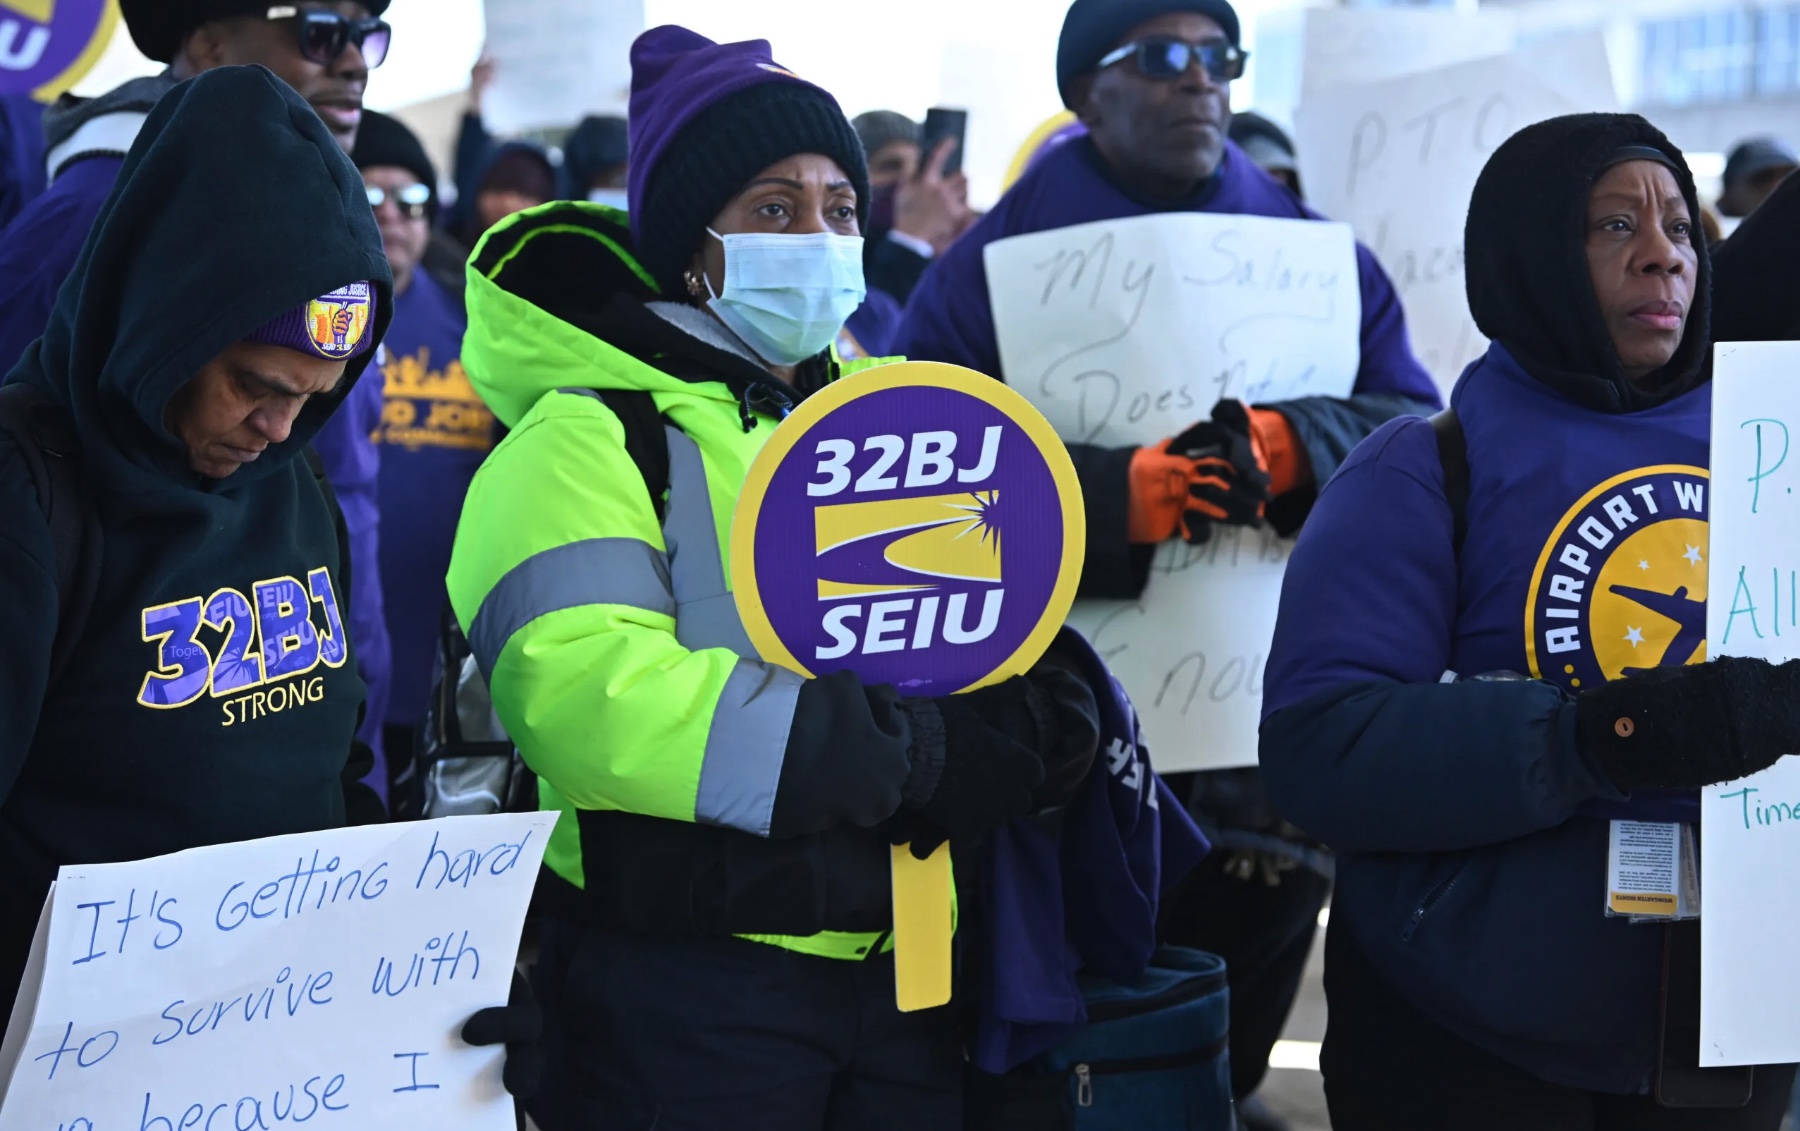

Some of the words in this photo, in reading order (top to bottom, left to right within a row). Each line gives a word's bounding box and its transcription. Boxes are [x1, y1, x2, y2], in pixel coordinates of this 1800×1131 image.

[1034, 231, 1156, 397] My
[1073, 369, 1194, 442] Does
[807, 425, 1003, 497] 32BJ
[1545, 484, 1659, 654] AIRPORT
[137, 566, 347, 709] 32BJ
[816, 589, 1004, 660] SEIU
[222, 677, 323, 726] STRONG
[1719, 787, 1800, 829] Time
[72, 888, 183, 965] It's
[417, 831, 532, 890] hard
[35, 1021, 119, 1080] to
[372, 931, 480, 998] with
[140, 1072, 350, 1131] because
[392, 1052, 440, 1093] I
